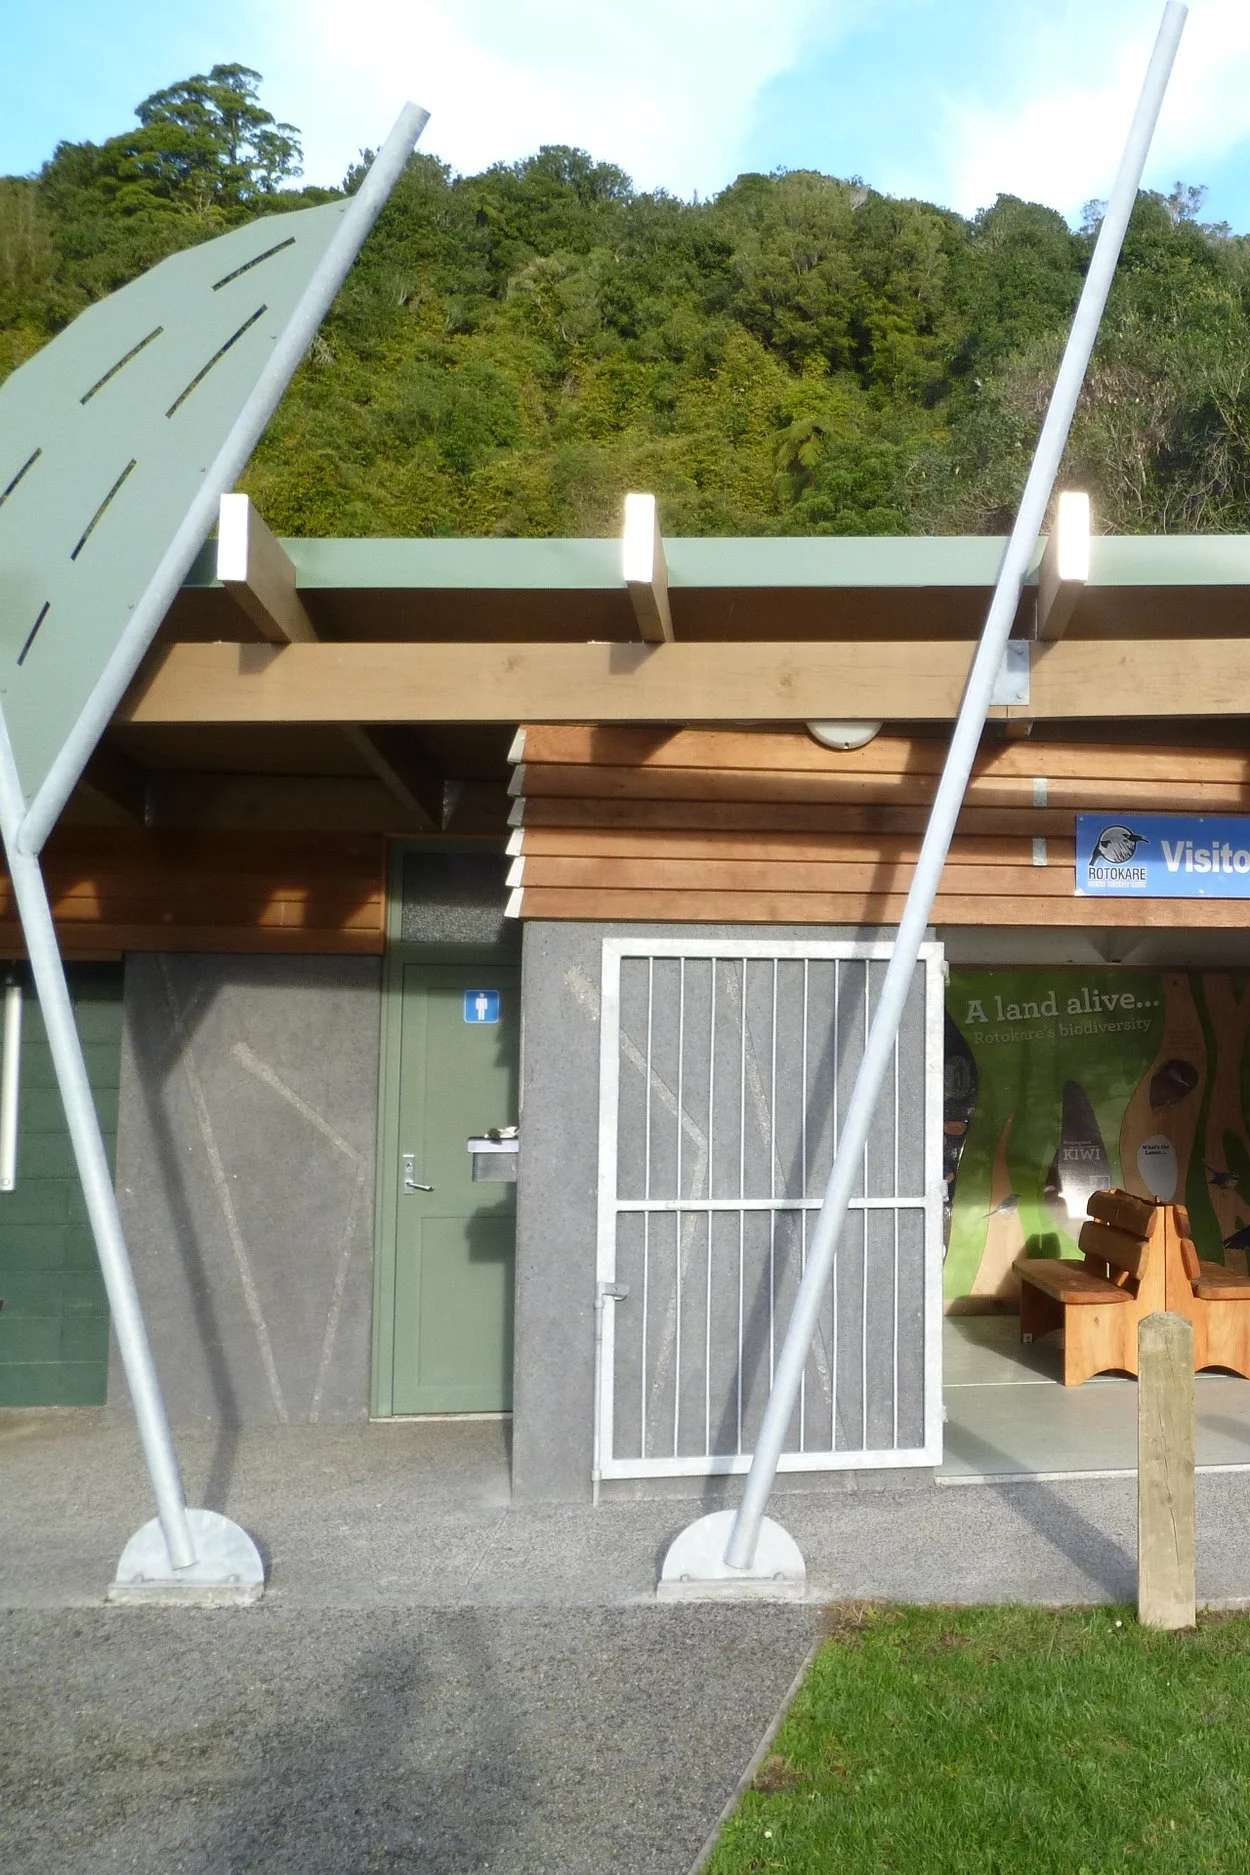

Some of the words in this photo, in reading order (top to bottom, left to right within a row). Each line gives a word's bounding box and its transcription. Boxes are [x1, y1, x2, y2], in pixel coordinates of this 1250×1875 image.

[1088, 867, 1146, 881] ROTOKARE
[964, 999, 988, 1024] A
[995, 990, 1059, 1021] land
[1067, 987, 1160, 1015] alive...
[974, 1025, 1055, 1045] Rotokare's
[1059, 1017, 1152, 1038] biodiversity
[1063, 1148, 1101, 1161] KIWI
